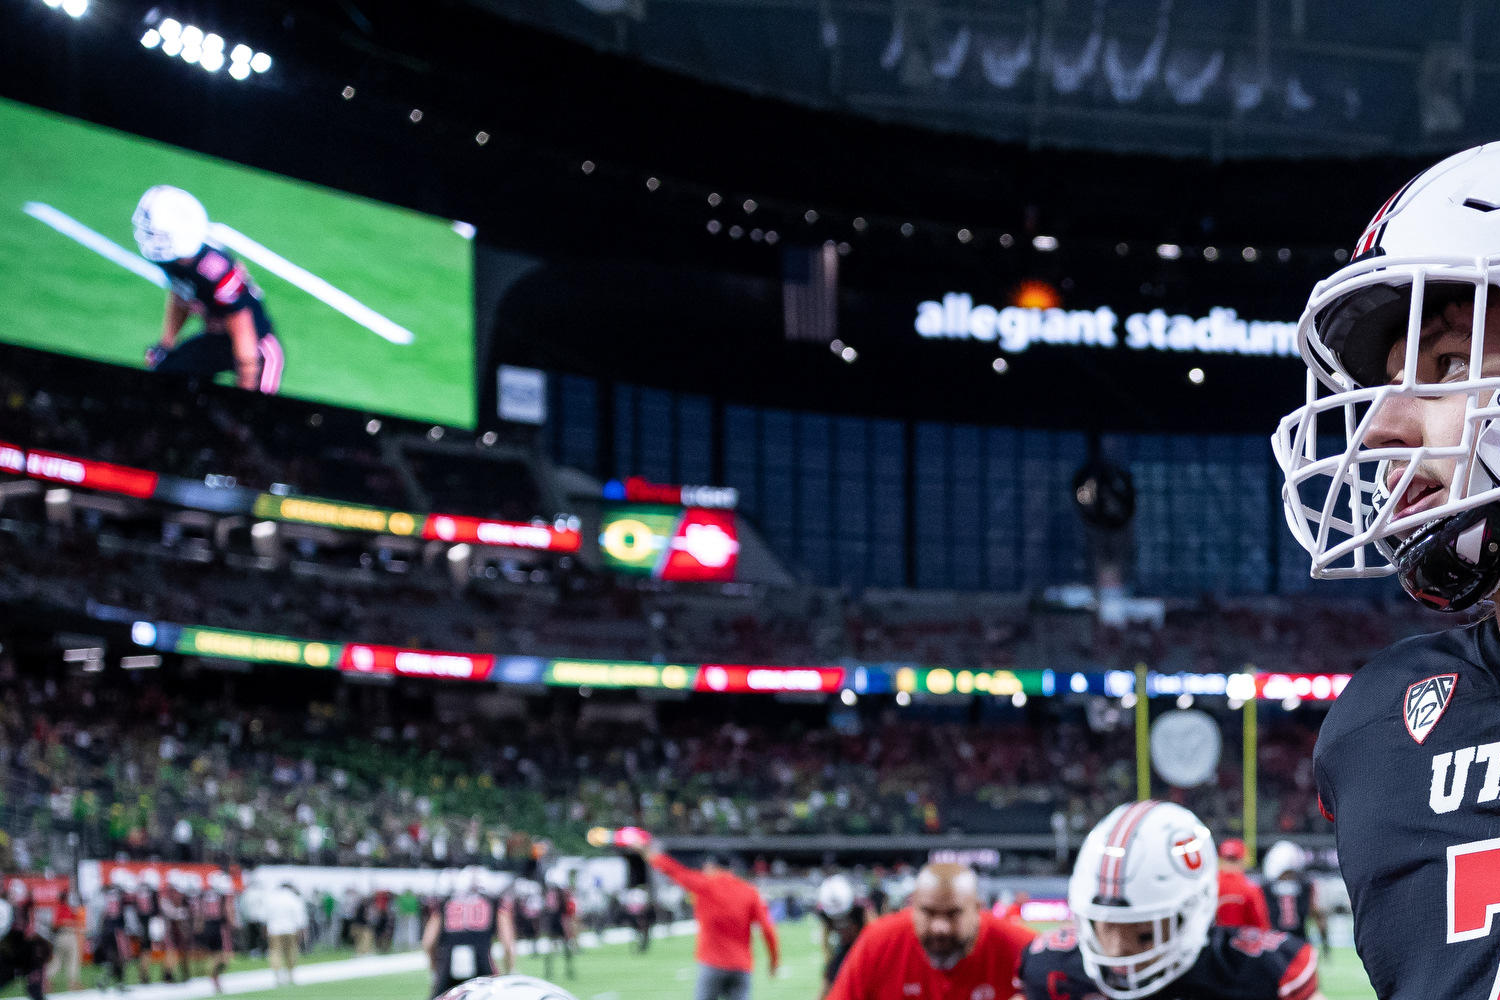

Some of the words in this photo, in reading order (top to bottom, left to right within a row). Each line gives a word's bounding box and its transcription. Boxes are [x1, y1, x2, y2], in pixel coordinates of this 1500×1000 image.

[914, 292, 1117, 352] allegiant
[1124, 304, 1300, 356] stadium
[1407, 676, 1455, 721] PAC
[1413, 701, 1438, 731] 12
